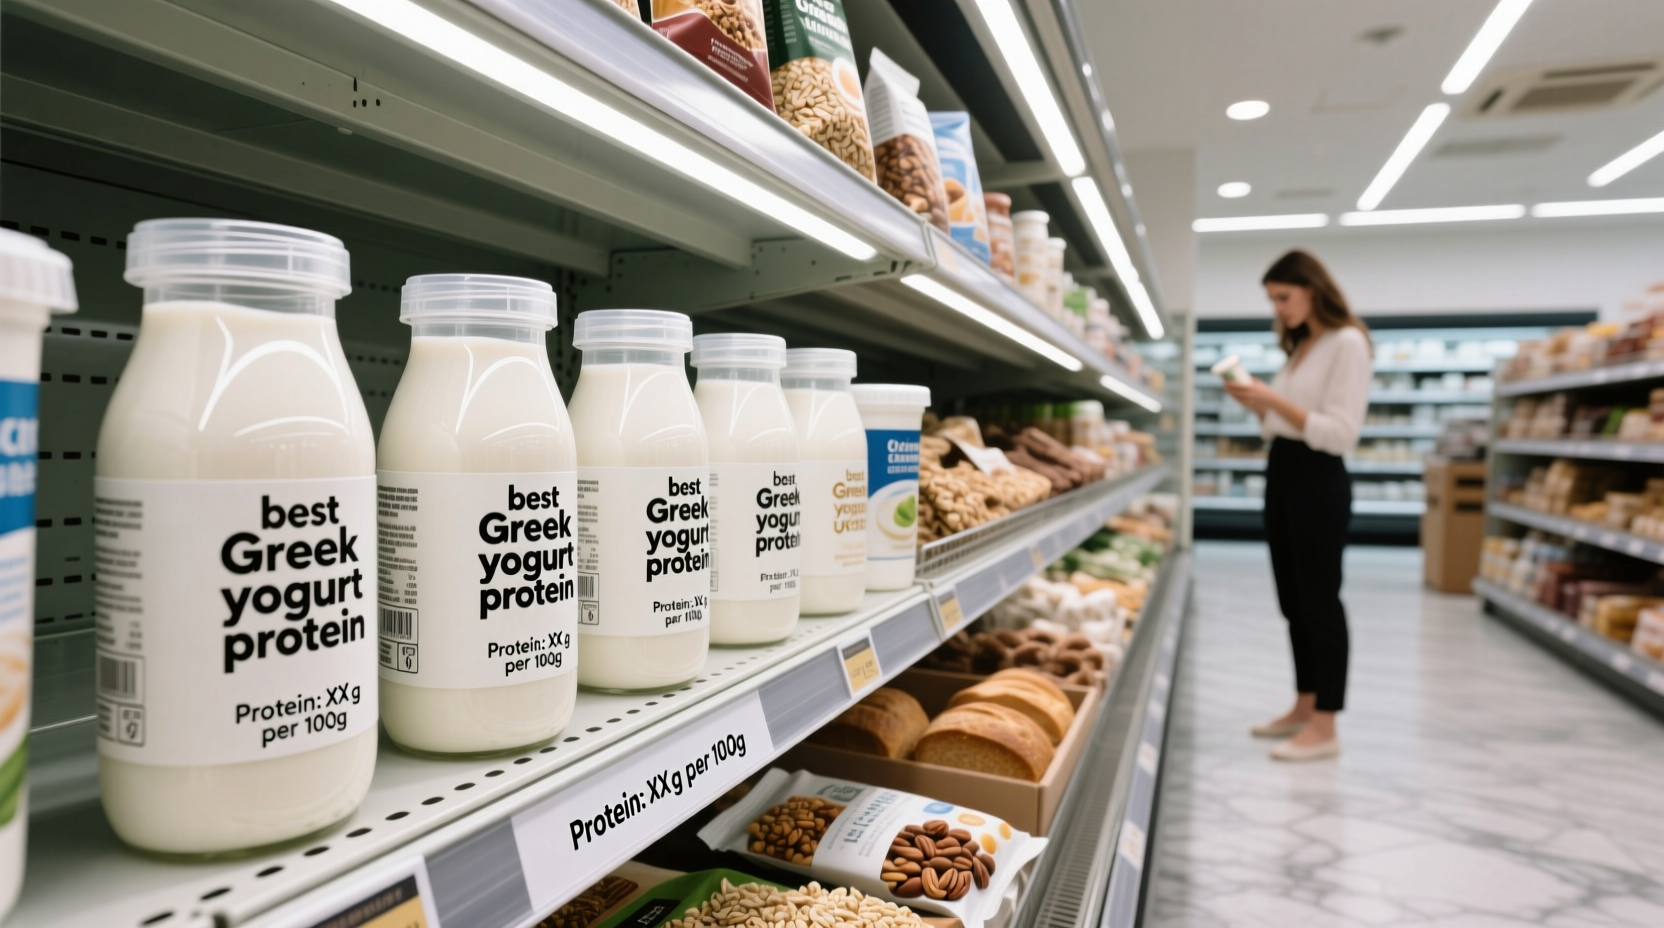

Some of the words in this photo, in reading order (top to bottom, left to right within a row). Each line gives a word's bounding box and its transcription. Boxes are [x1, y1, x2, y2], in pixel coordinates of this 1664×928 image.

[508, 484, 560, 511] best
[668, 475, 702, 497] best
[261, 495, 339, 530] best
[478, 509, 572, 545] Greek
[646, 495, 709, 524] Greek
[220, 525, 359, 576] Greek
[645, 522, 709, 555] yogurt
[478, 541, 574, 585] yogurt
[646, 547, 710, 583] protein
[220, 568, 363, 627] yogurt
[479, 573, 574, 620] protein
[223, 608, 365, 674] protein
[488, 636, 546, 659] Protein:
[505, 656, 531, 677] per
[534, 651, 562, 668] 100g
[235, 694, 322, 725] Protein:
[262, 720, 299, 749] per
[304, 711, 347, 736] 100g
[569, 791, 647, 851] Protein:
[685, 753, 710, 789] per
[711, 733, 747, 767] 100g
